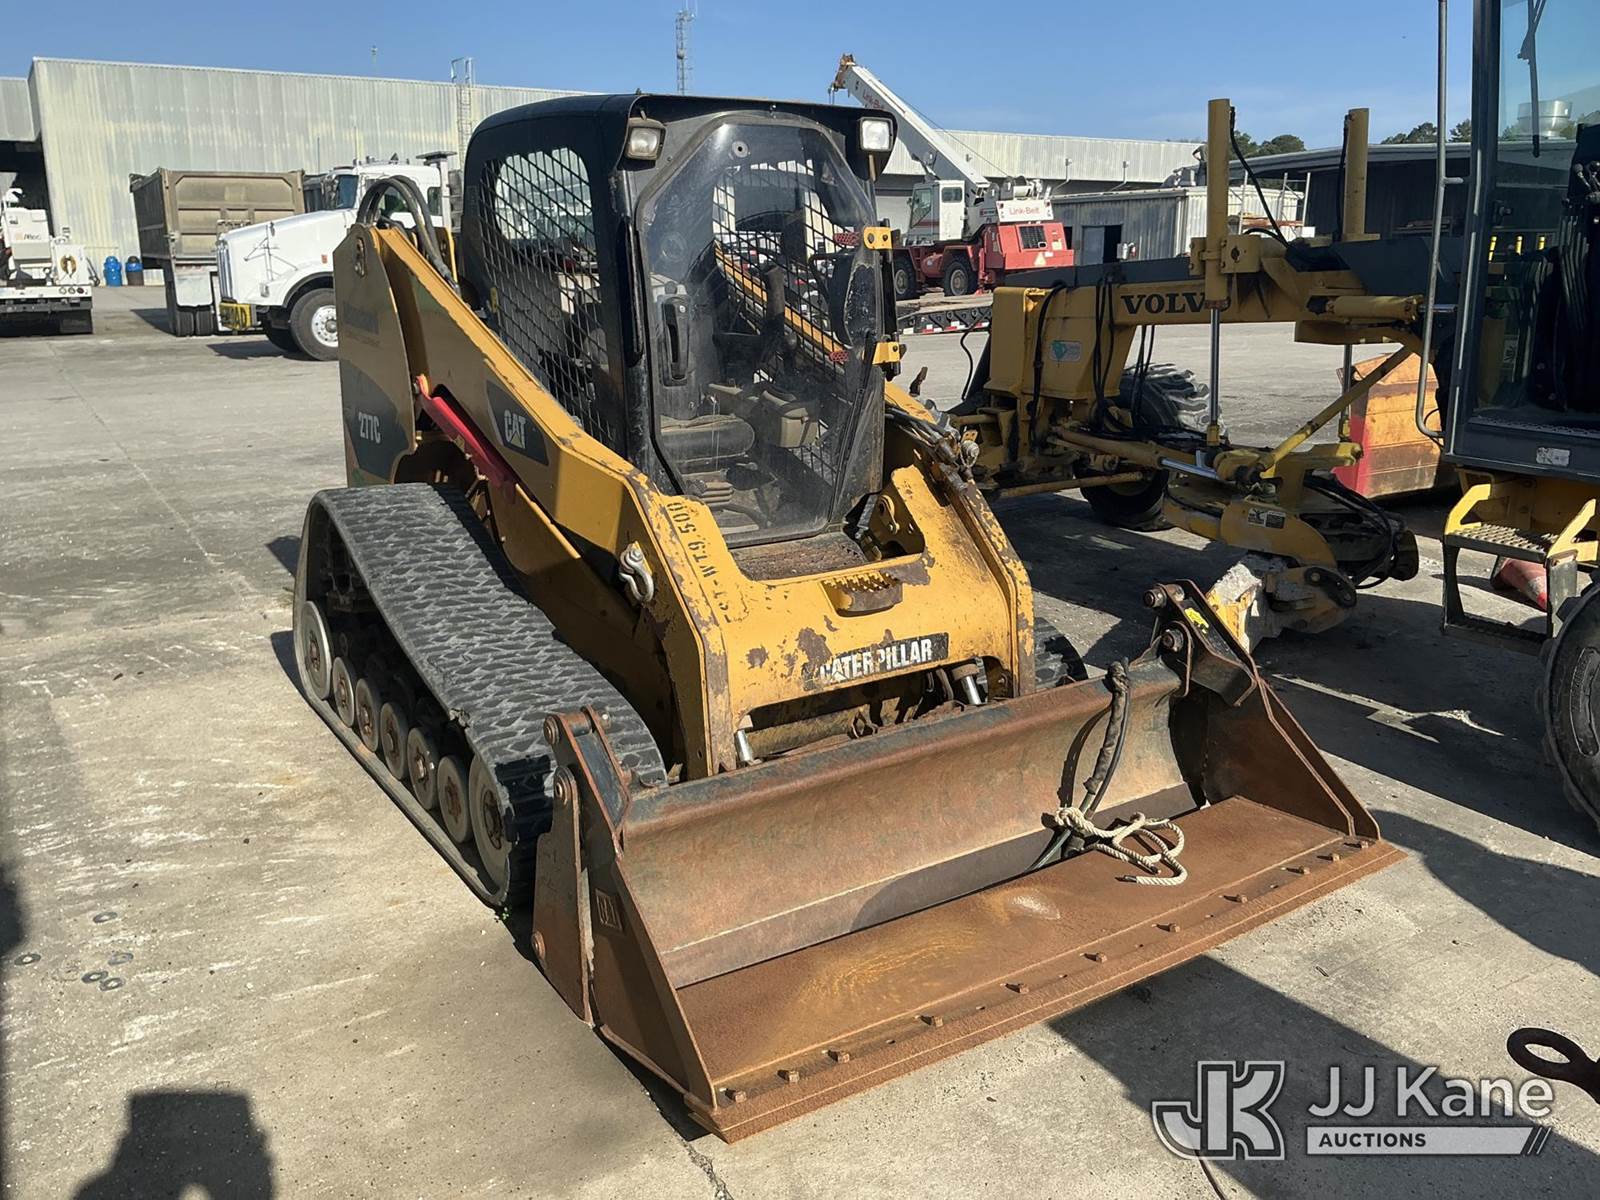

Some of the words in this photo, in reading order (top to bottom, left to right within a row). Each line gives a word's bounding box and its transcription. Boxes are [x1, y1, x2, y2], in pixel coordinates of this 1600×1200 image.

[1008, 206, 1041, 215] Link-Belt
[358, 411, 381, 444] 277C
[504, 409, 526, 449] CAT
